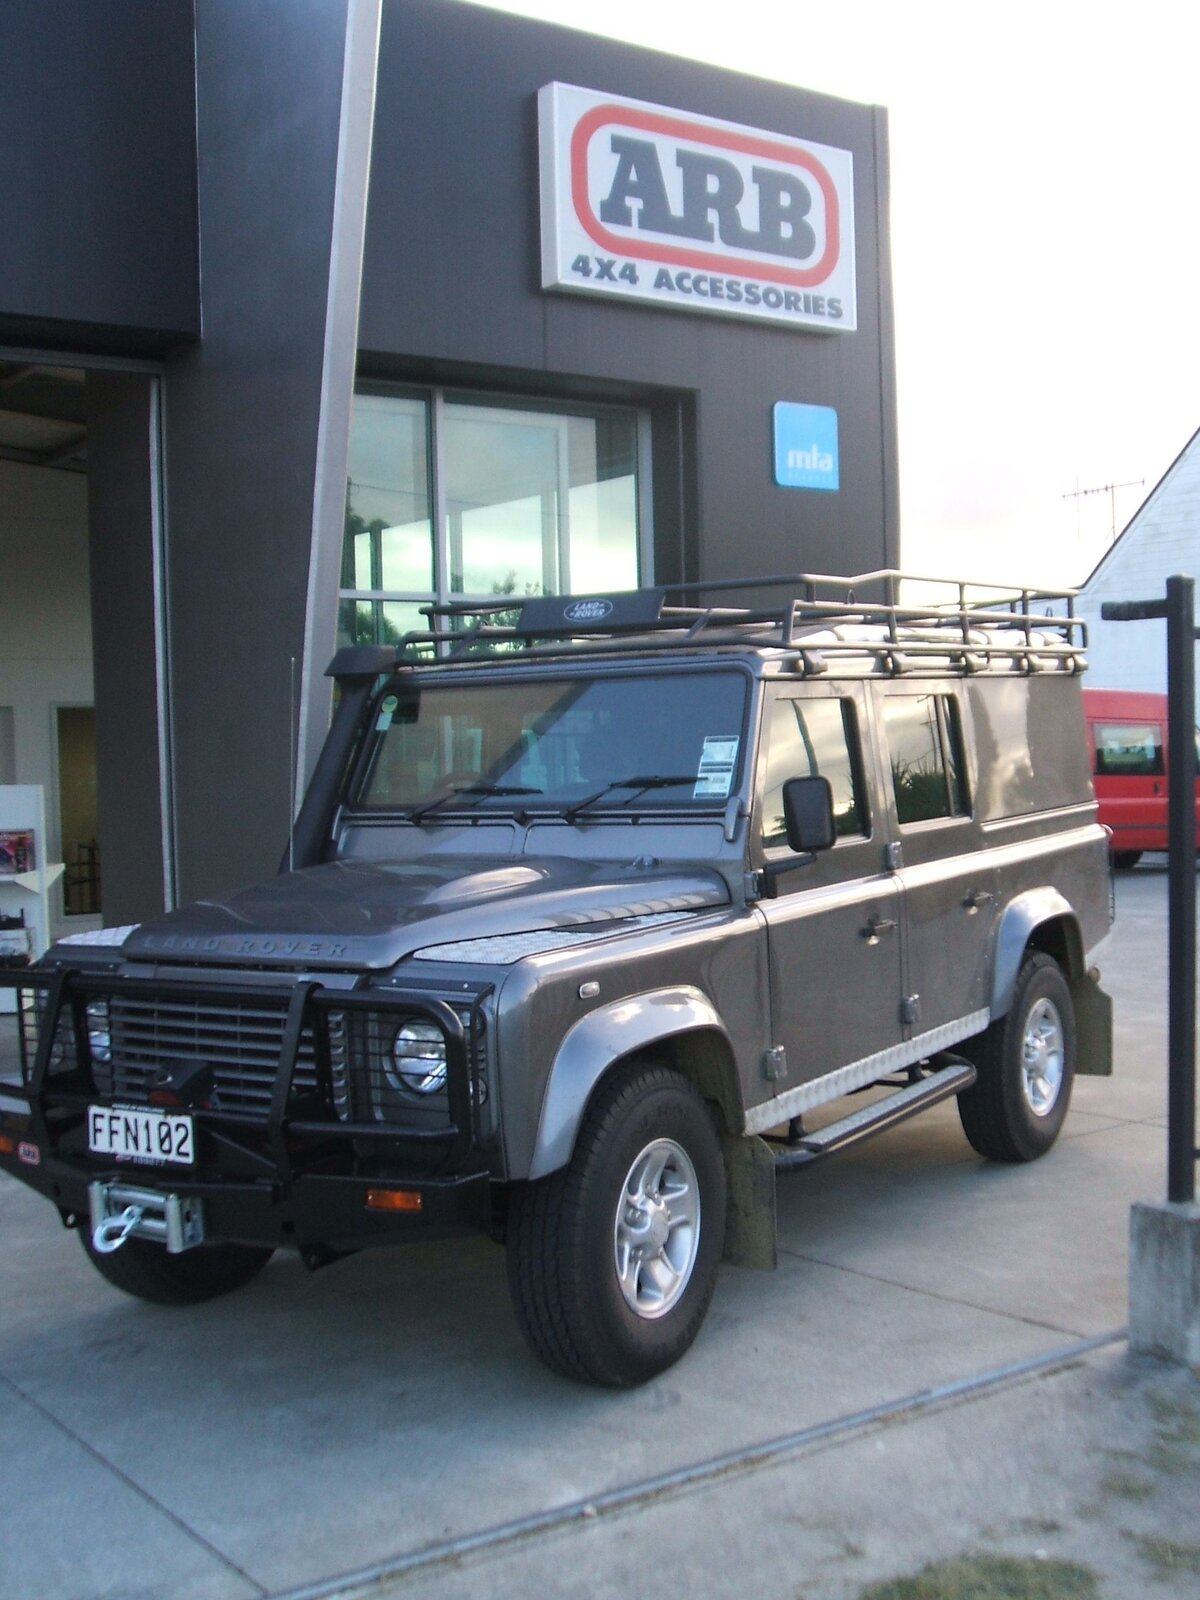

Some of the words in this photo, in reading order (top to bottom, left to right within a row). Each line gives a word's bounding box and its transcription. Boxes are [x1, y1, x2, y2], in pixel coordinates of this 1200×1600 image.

[599, 133, 817, 260] ARB
[571, 254, 640, 285] 4X4
[653, 268, 844, 320] ACCESSORIES
[143, 935, 224, 950] LAND
[237, 939, 346, 958] ROVER
[92, 1113, 190, 1158] FFN102
